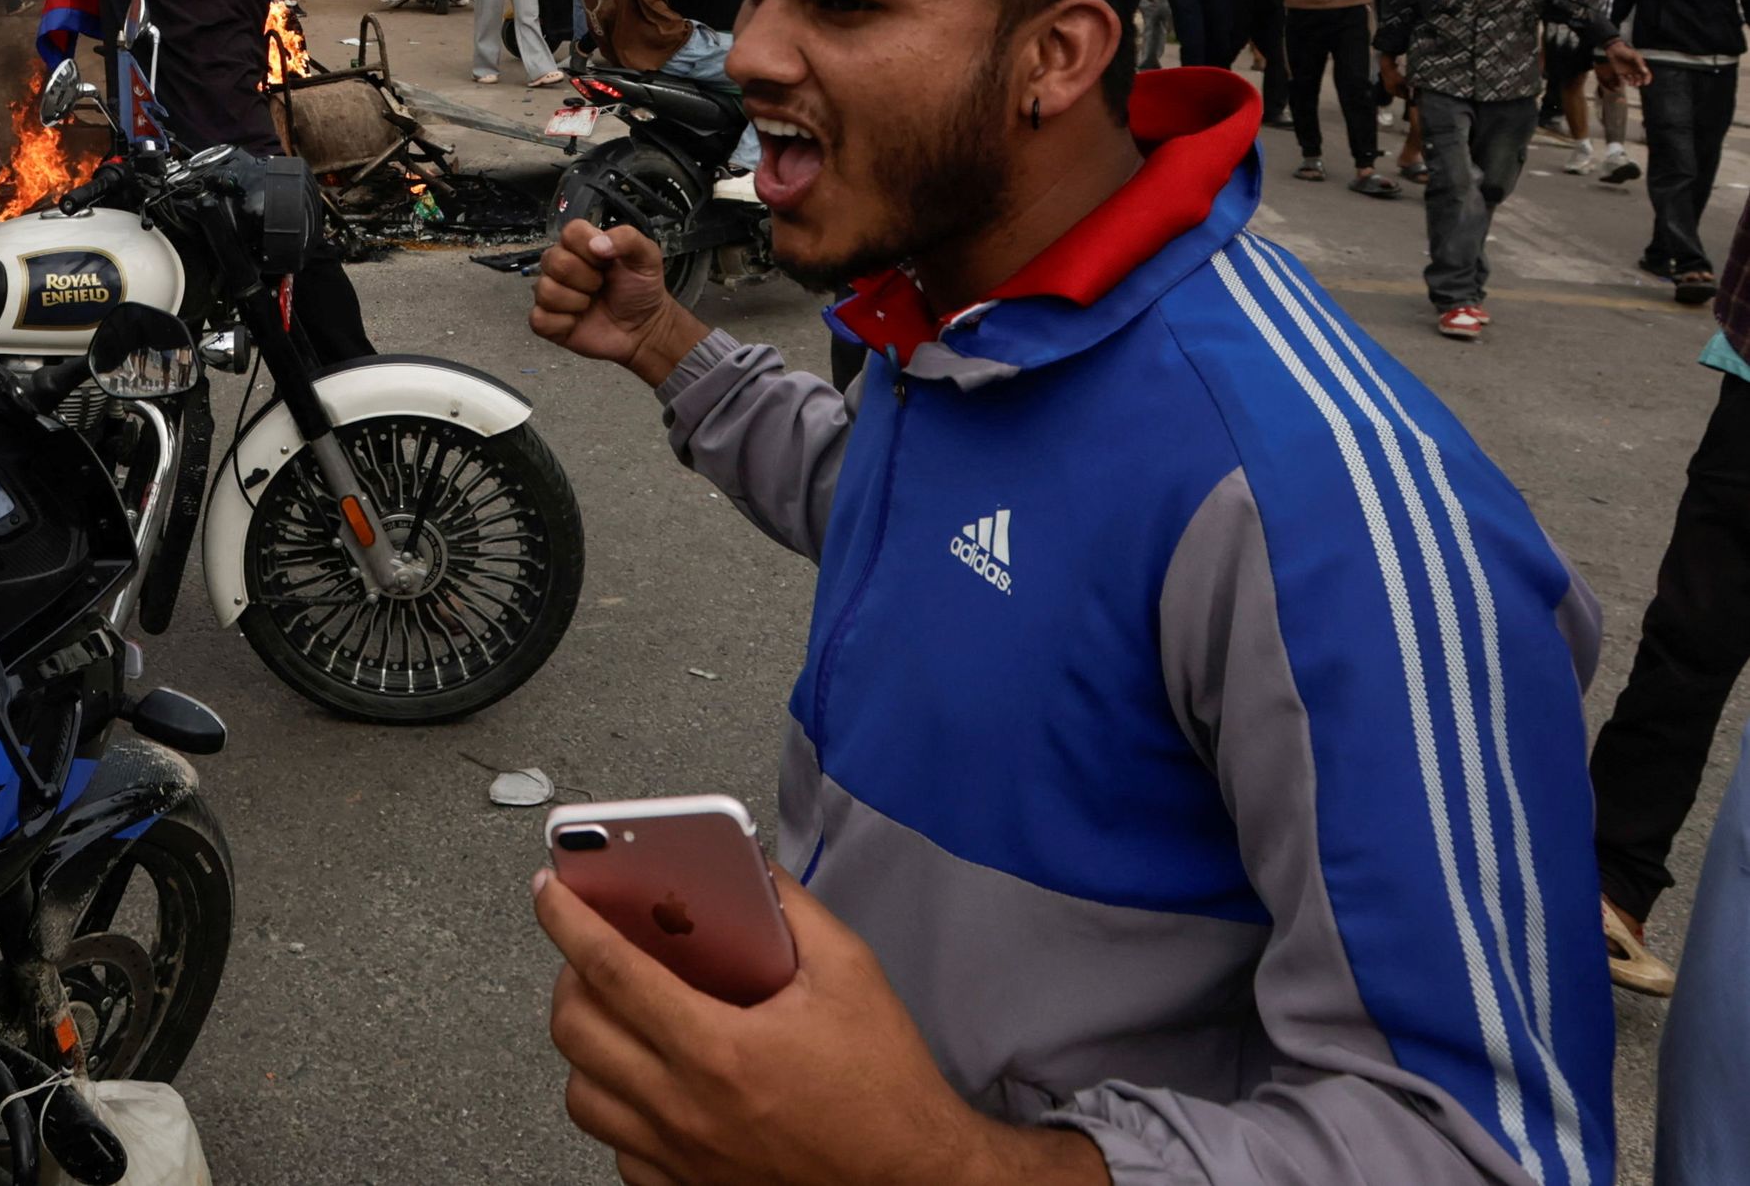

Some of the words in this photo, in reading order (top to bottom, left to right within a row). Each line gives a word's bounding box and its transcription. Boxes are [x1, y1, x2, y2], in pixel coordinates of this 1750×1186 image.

[46, 273, 102, 290] ROYAL
[42, 288, 109, 307] ENFIELD
[950, 536, 1012, 592] adidas
